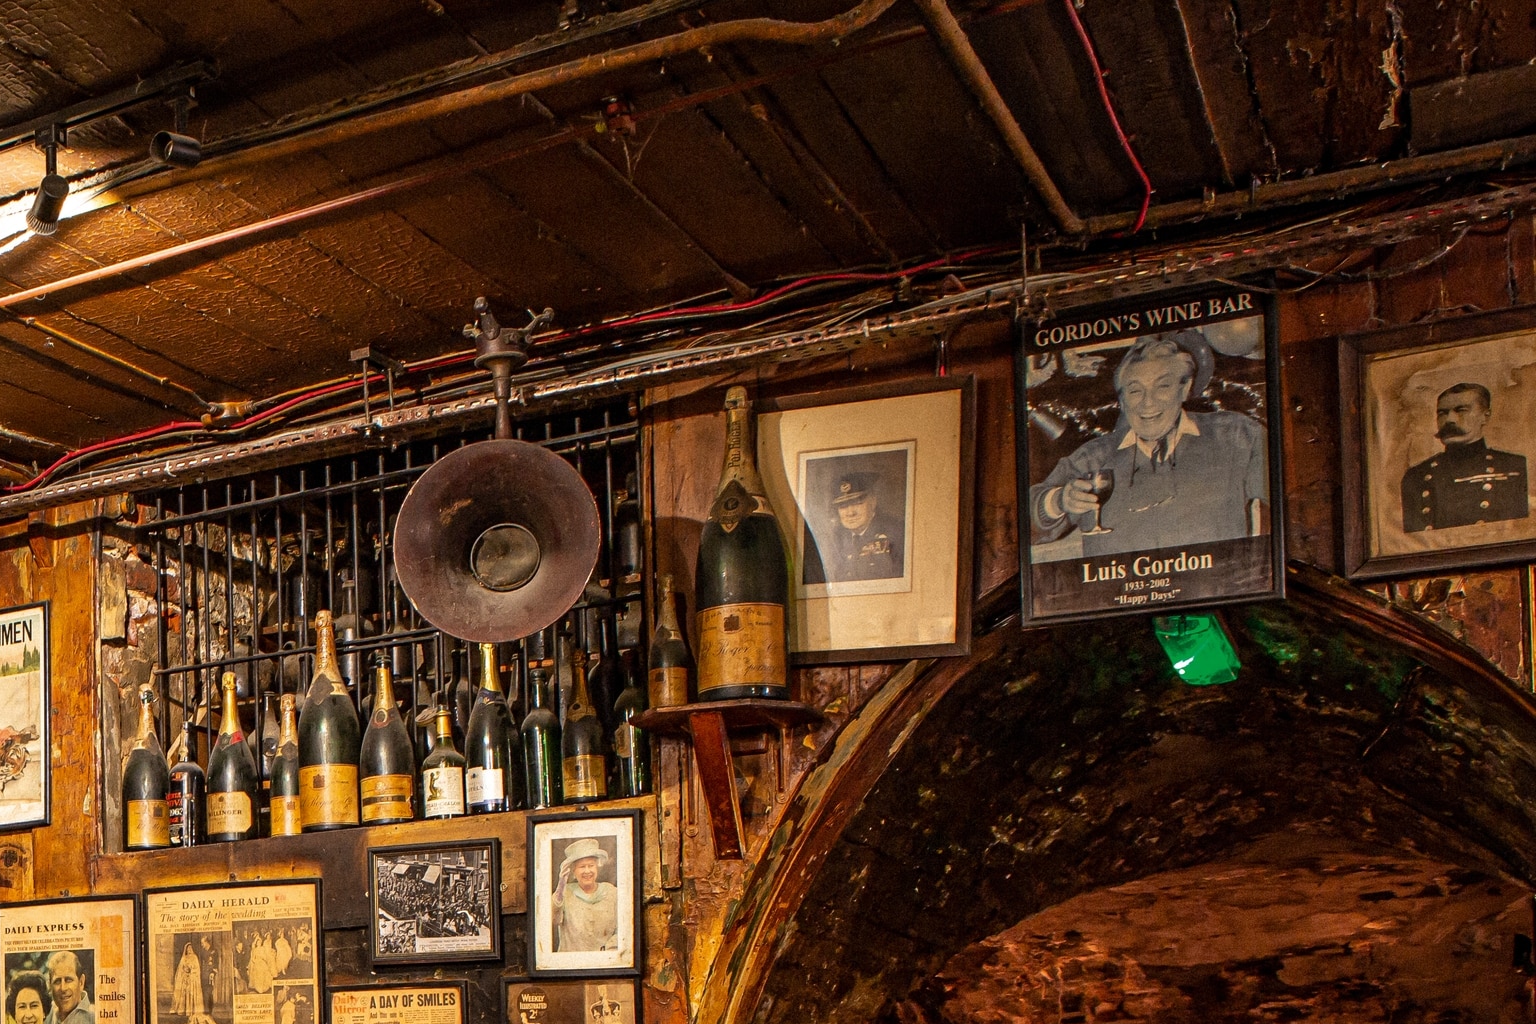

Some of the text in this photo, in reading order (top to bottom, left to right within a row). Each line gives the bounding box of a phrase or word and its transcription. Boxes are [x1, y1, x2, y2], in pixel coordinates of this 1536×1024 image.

[1034, 293, 1253, 347] GORDON'S WINE BAR
[1082, 552, 1213, 583] Luis Gordon
[1124, 578, 1170, 591] 1933-2002
[182, 896, 270, 910] DAILY HERALD
[160, 914, 175, 922] The
[179, 913, 199, 922] story
[202, 911, 210, 921] of
[214, 911, 227, 920] the
[231, 909, 266, 919] wedding
[5, 923, 84, 934] DAILY EXPRESS
[99, 974, 116, 985] The
[99, 992, 126, 1001] smiles
[334, 995, 358, 1005] Daily
[369, 992, 456, 1009] A DAY OF SMILES
[521, 994, 545, 1003] WEEKLY
[334, 1005, 367, 1014] Mirror
[520, 1002, 547, 1010] ILLUSTRATED
[99, 1008, 118, 1019] that
